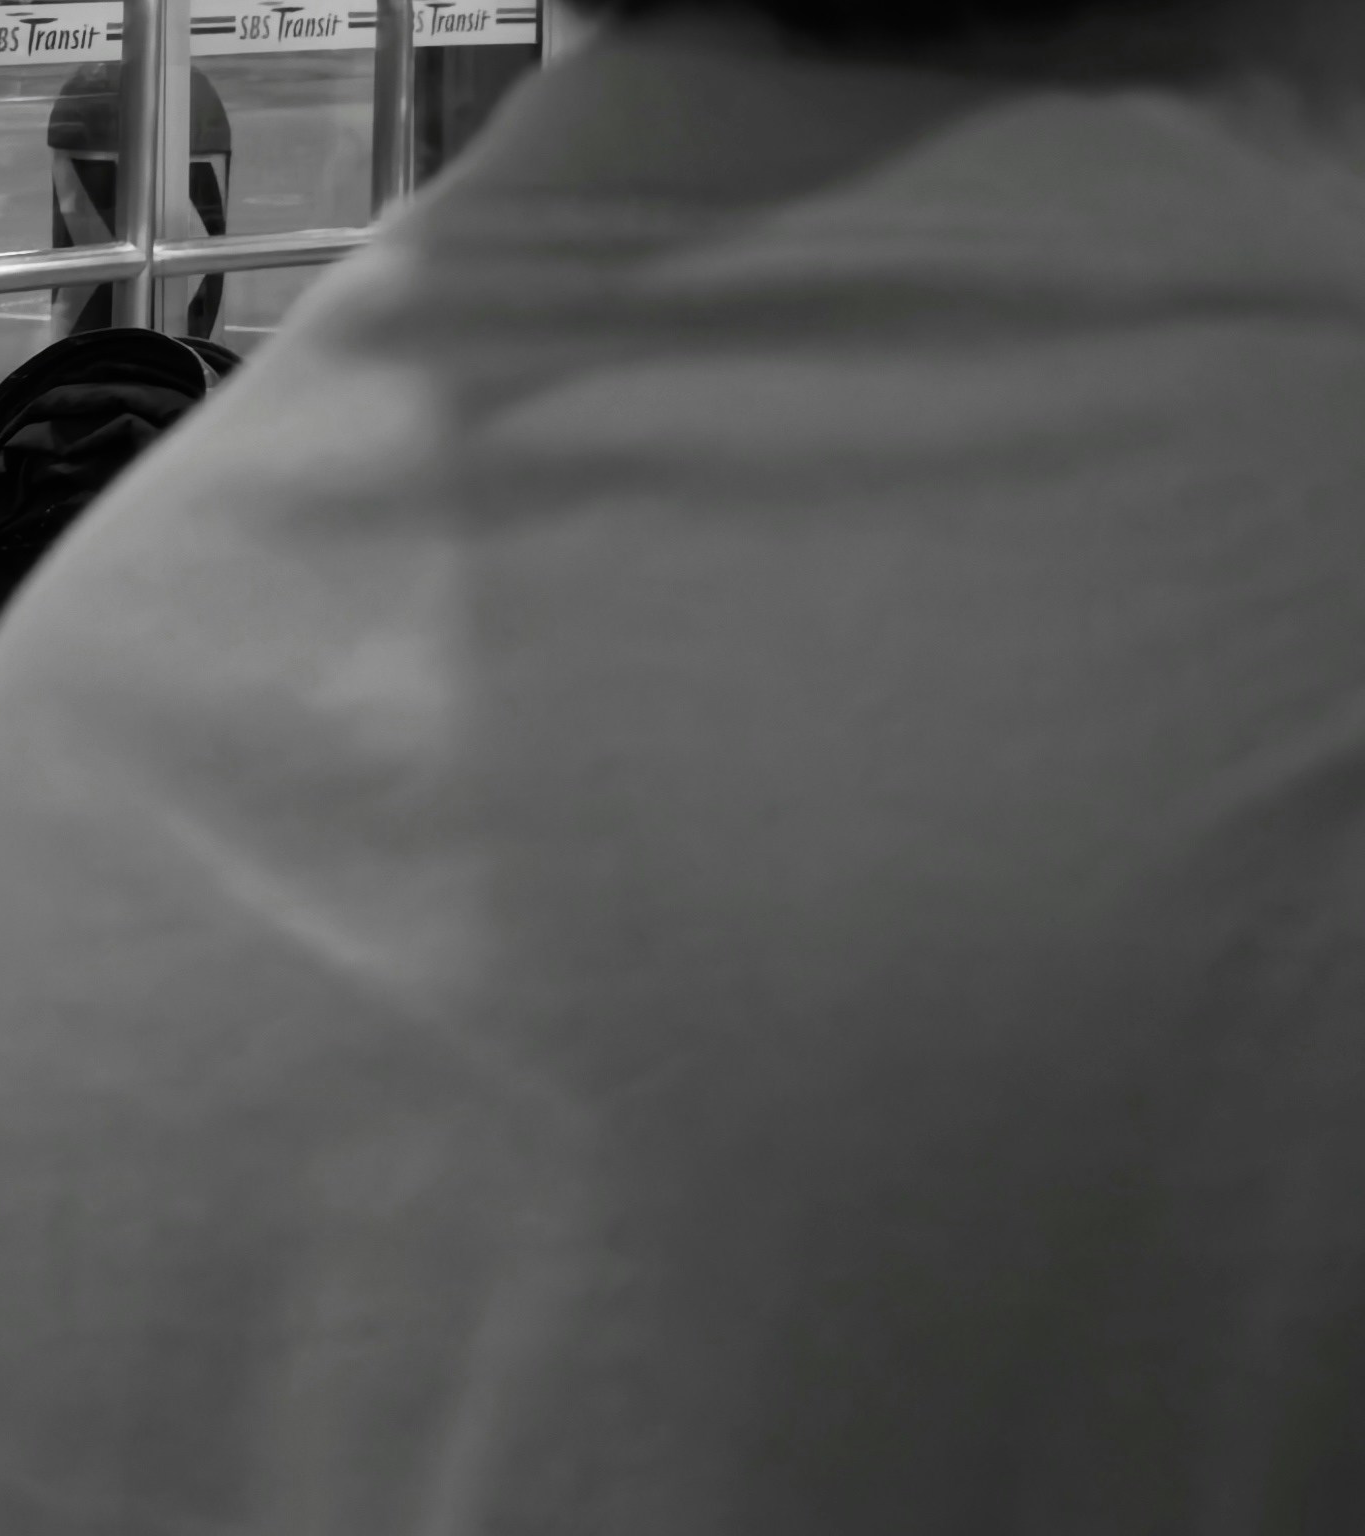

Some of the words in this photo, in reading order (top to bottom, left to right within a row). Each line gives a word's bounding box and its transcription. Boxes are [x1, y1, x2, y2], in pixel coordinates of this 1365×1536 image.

[18, 16, 101, 57] Transit
[240, 13, 271, 41] SBS
[270, 6, 343, 43] Transit
[424, 2, 492, 36] Transit
